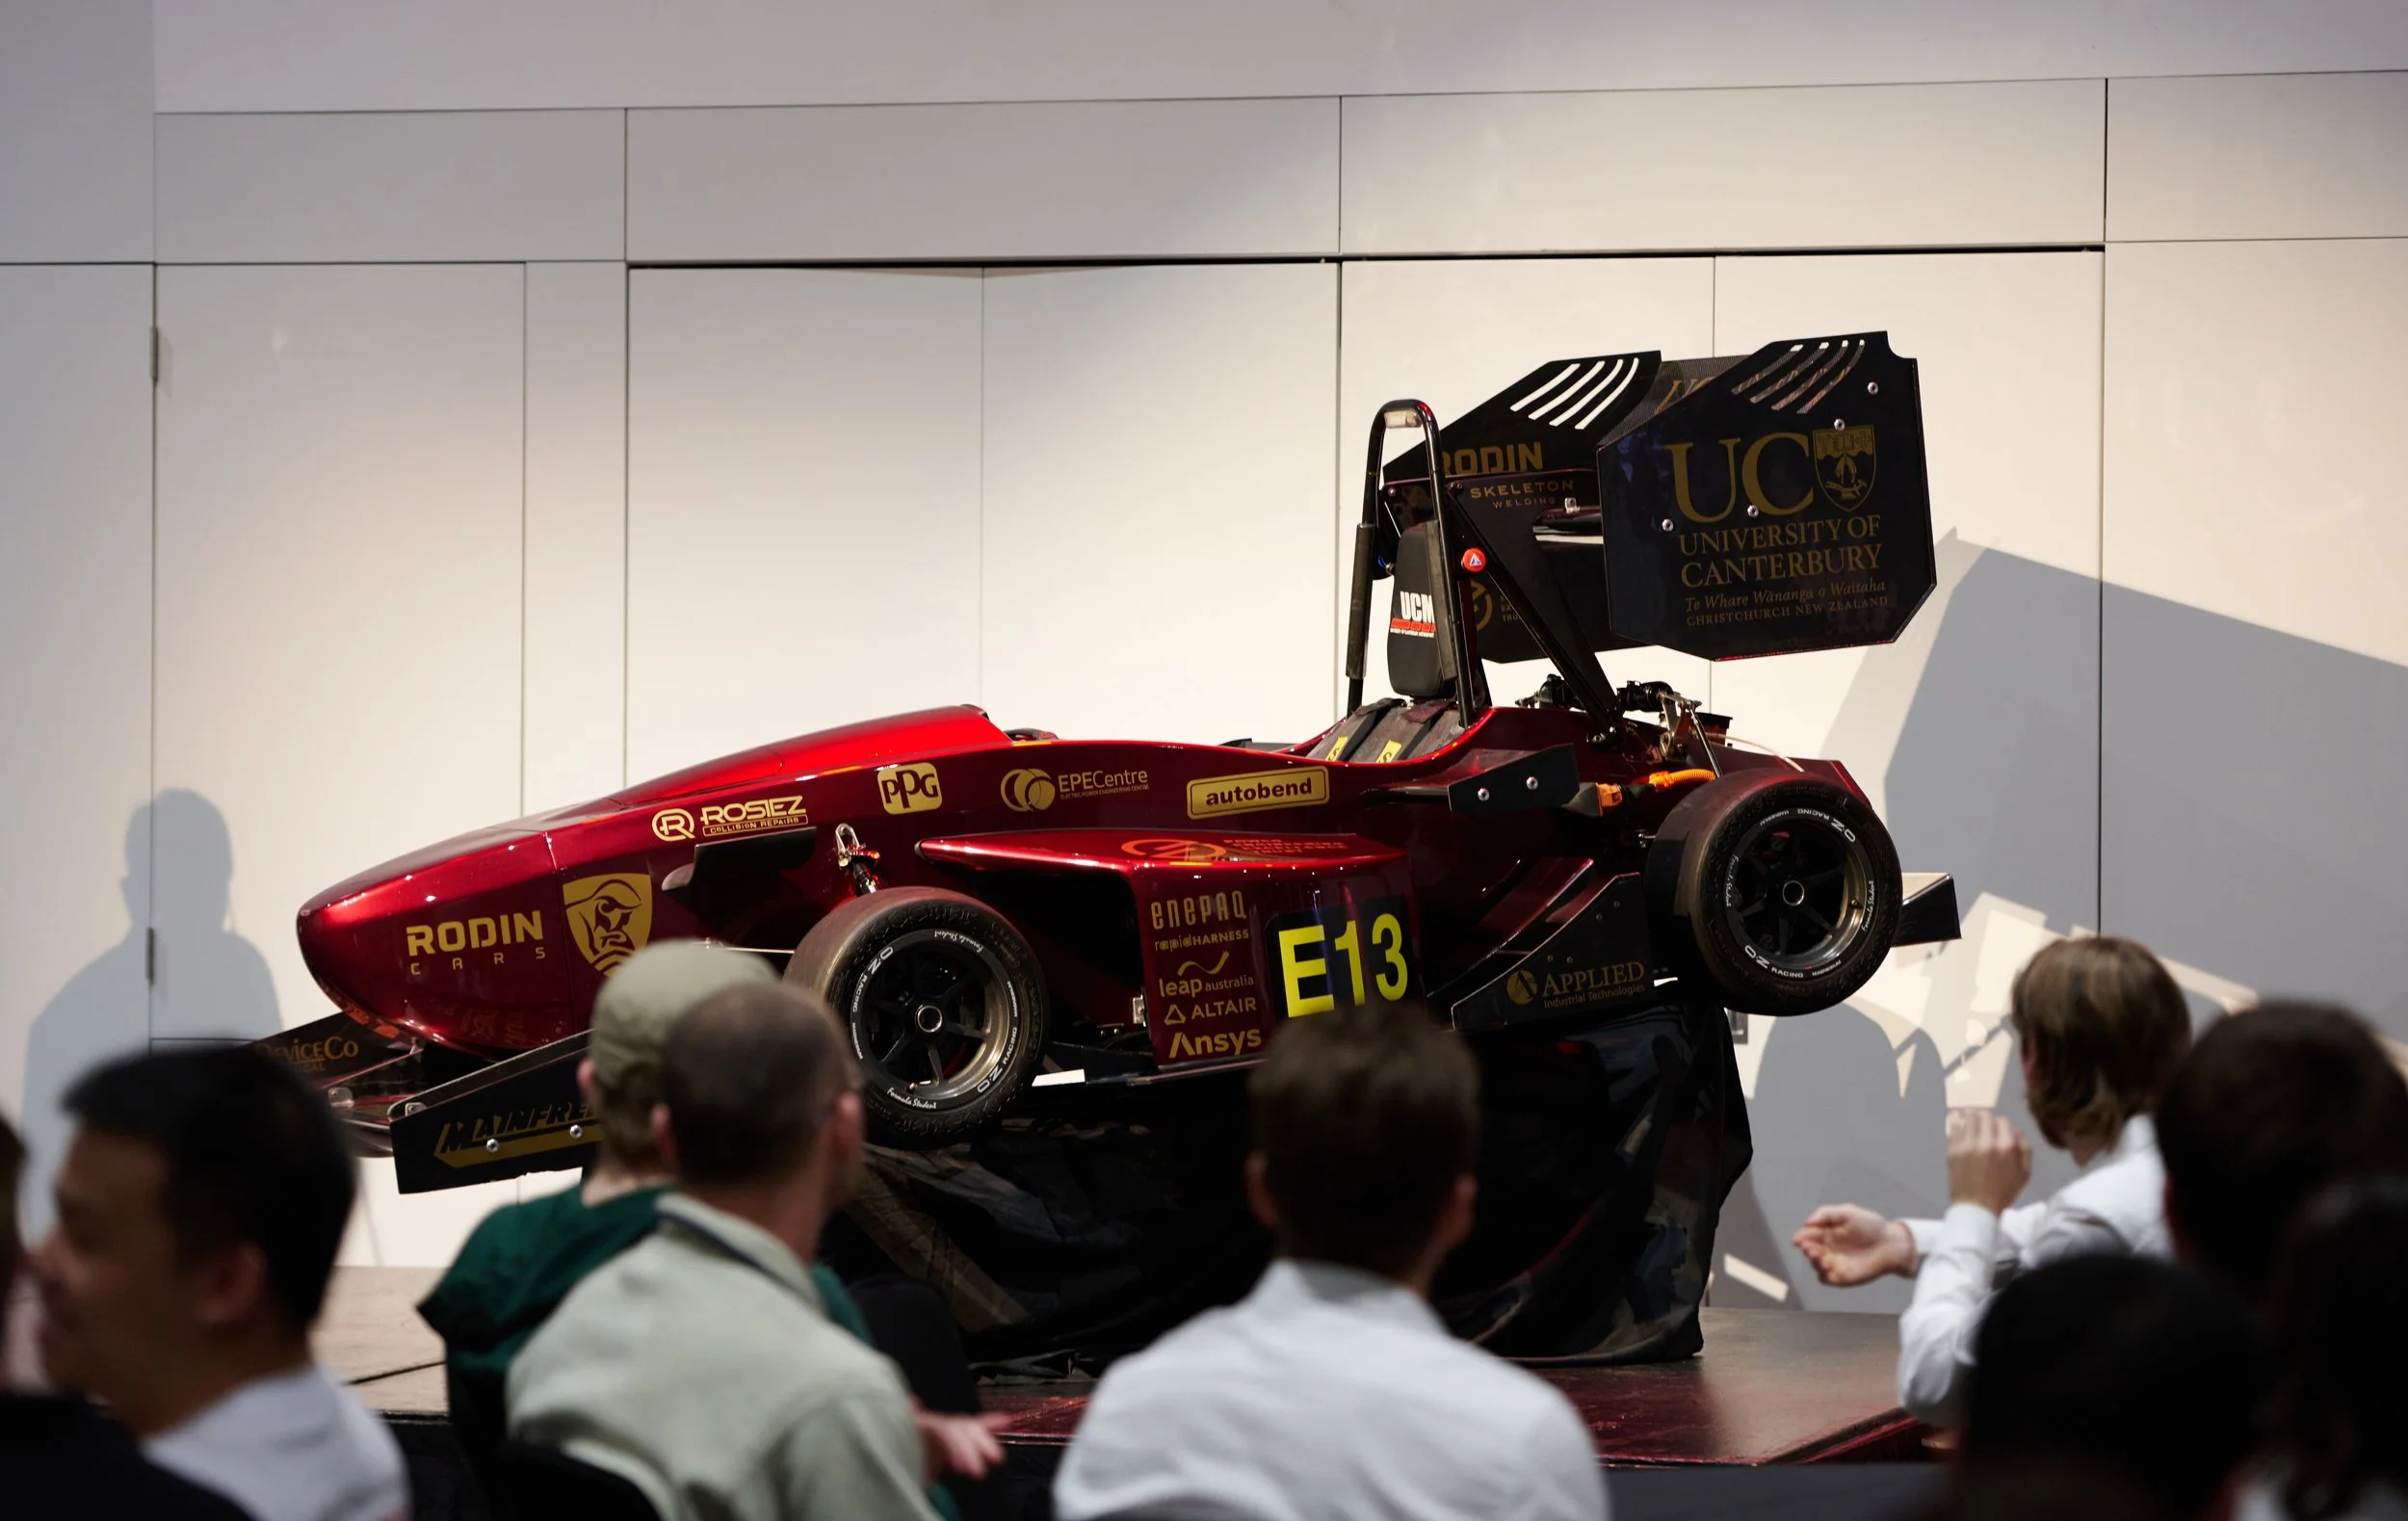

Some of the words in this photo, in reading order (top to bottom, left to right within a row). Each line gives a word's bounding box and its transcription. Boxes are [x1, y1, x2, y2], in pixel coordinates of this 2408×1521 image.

[1470, 479, 1574, 499] SKELETON
[1663, 432, 1815, 524] UC
[1492, 496, 1557, 510] WELDING
[1678, 518, 1846, 557] UNIVERSITY
[1846, 514, 1881, 539] OF
[1681, 543, 1883, 590] CANTERBURY
[1400, 590, 1435, 624] UCM
[1686, 597, 1701, 613] Te
[1705, 591, 1750, 610] Whare
[1830, 577, 1887, 594] Waitaha
[1687, 606, 1793, 626] CHRISTCHURCH
[1795, 602, 1823, 616] NEW
[1829, 595, 1889, 612] ZEALAND
[881, 769, 938, 809] PPG
[1058, 769, 1148, 794] EPECentre
[1205, 776, 1313, 806] autobend
[700, 795, 807, 826] ROSIEZ
[710, 822, 758, 835] COLLISION
[760, 816, 800, 829] REPAIRS
[1797, 808, 1830, 820] RACING
[406, 909, 544, 957] RODIN
[1154, 928, 1250, 953] rapidHARNESS
[409, 946, 546, 977] CARS
[1278, 912, 1409, 1018] E13
[1770, 966, 1804, 979] RACING
[852, 974, 868, 1013] RACING
[1159, 978, 1203, 999] leap
[1205, 974, 1255, 993] australia
[1541, 961, 1646, 998] APPLIED
[1191, 996, 1258, 1021] ALTAIR
[1544, 993, 1587, 1010] Industrial
[1587, 983, 1646, 1002] Technologies
[1002, 1027, 1017, 1065] RACING
[1168, 1028, 1263, 1060] Ansys
